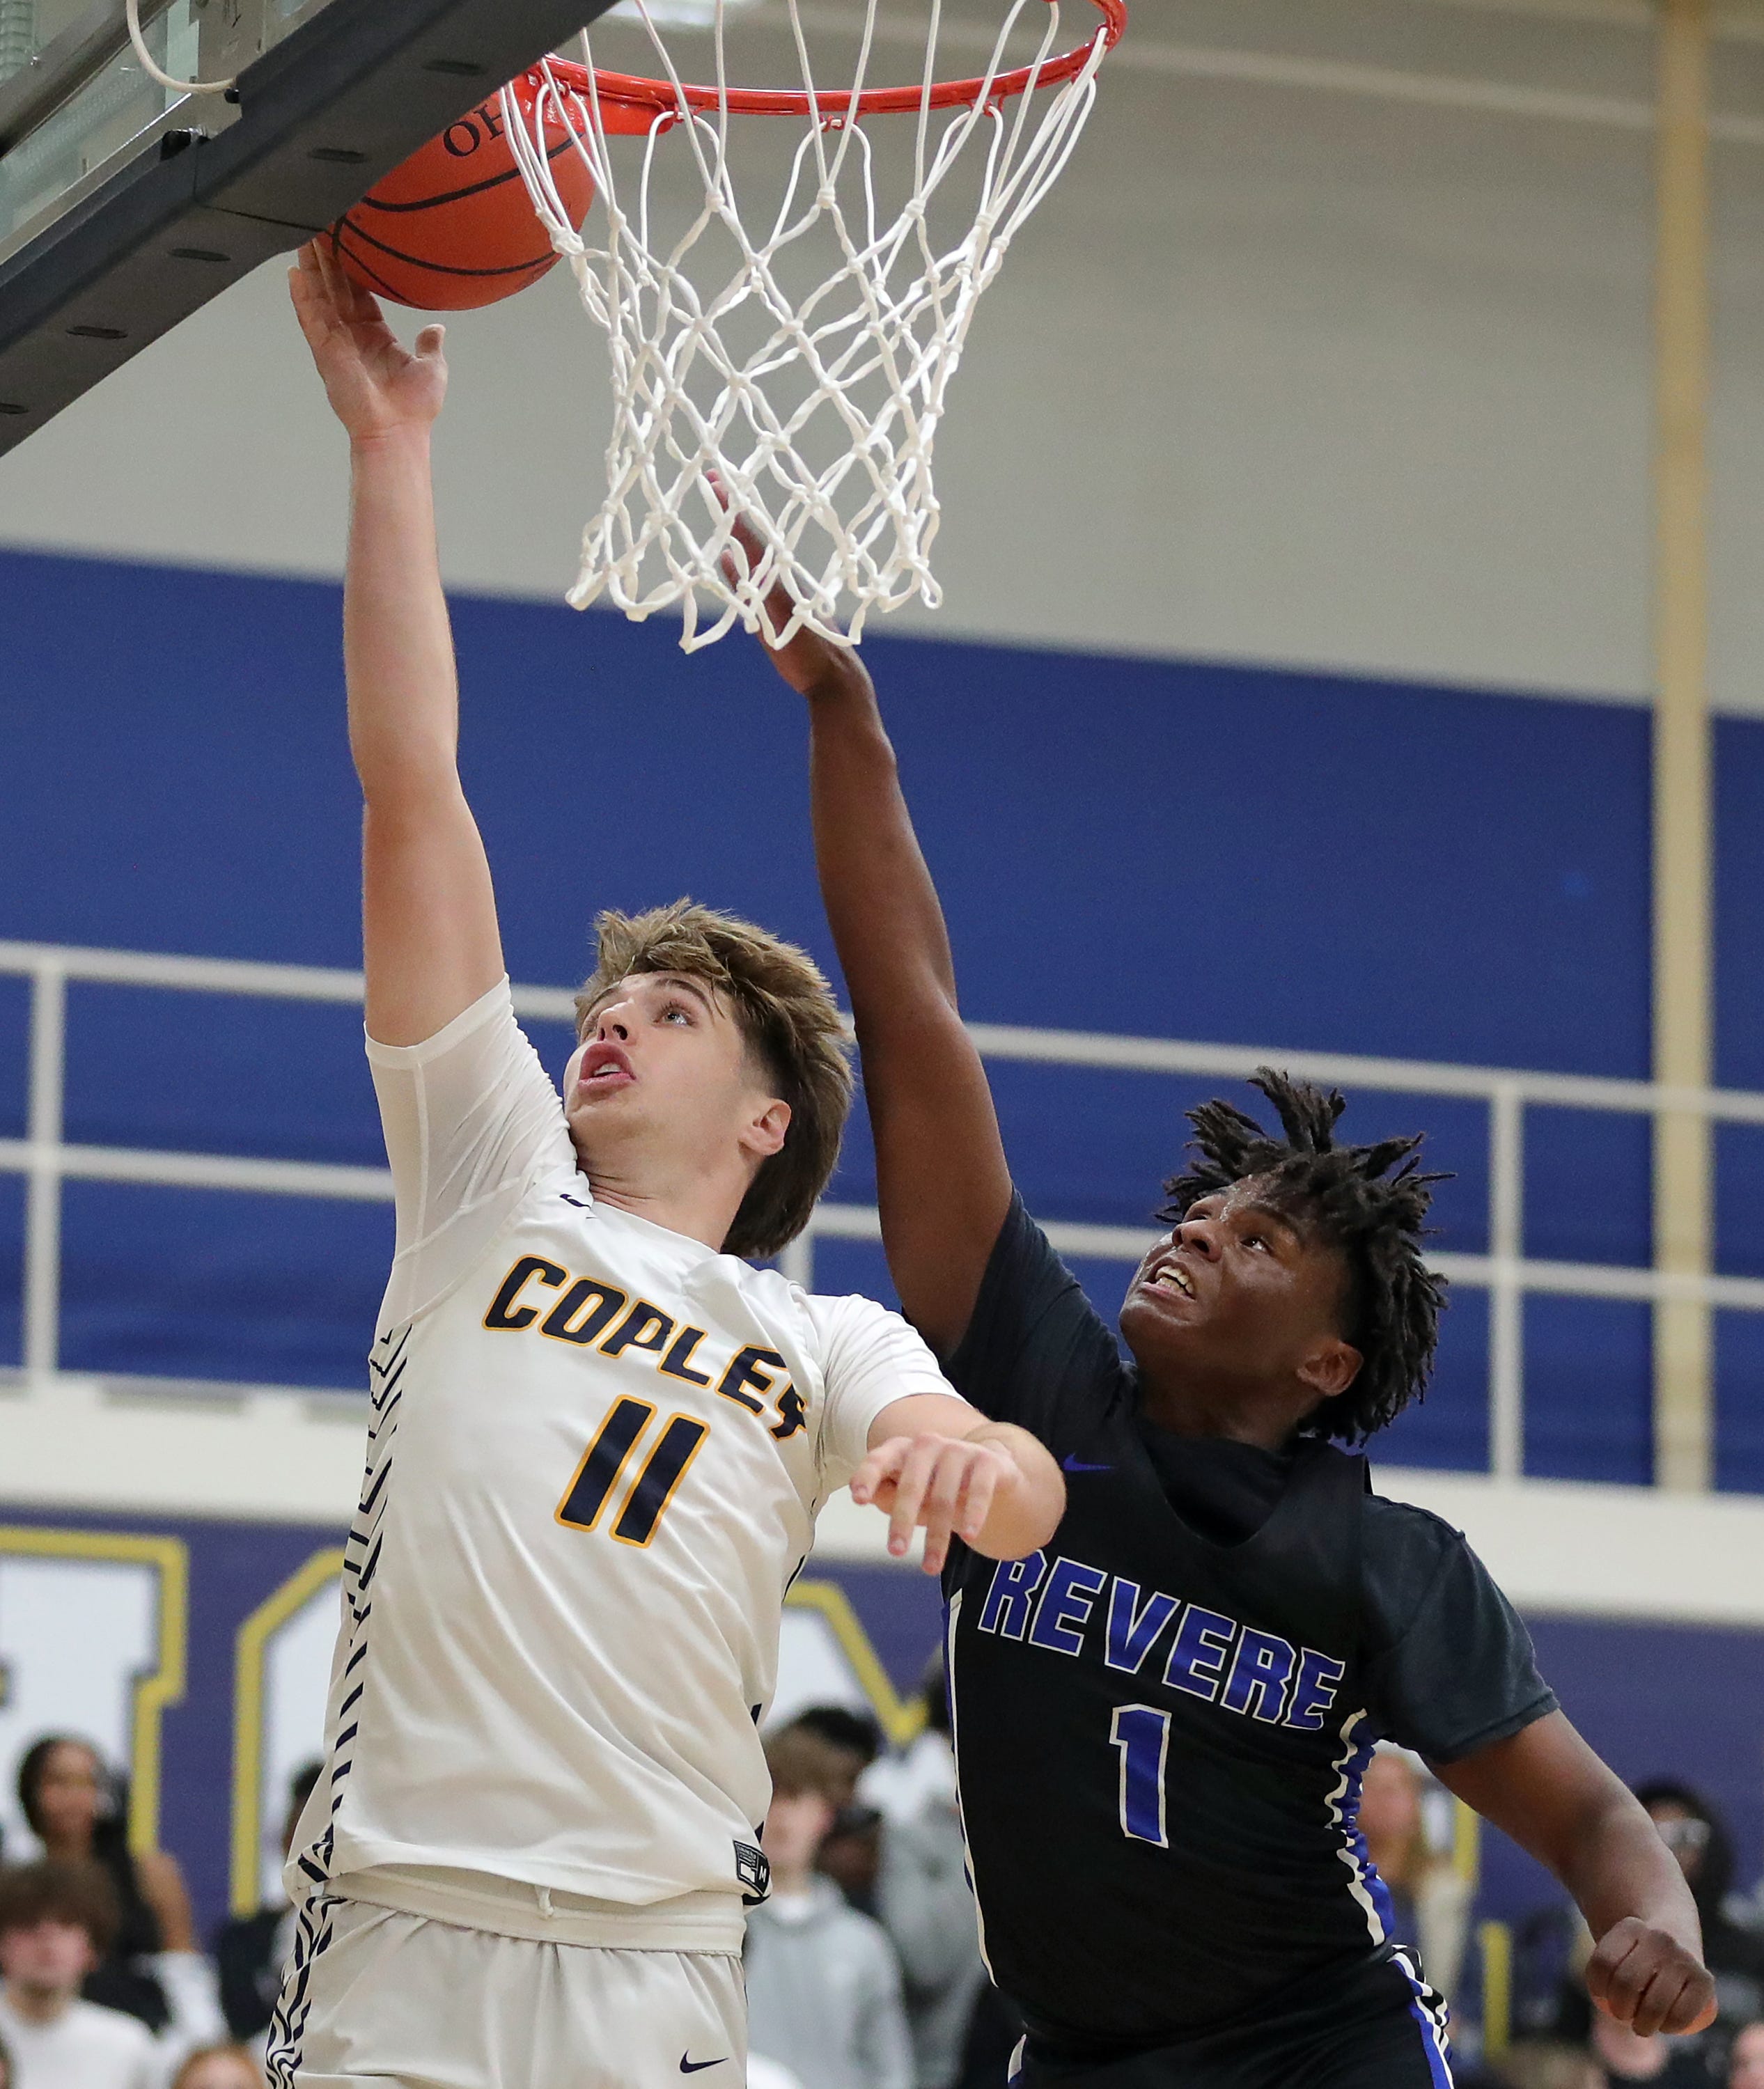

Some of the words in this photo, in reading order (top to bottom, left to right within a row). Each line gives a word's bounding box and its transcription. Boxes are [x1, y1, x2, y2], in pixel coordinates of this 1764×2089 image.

[554, 1394, 710, 1549] 11
[978, 1549, 1345, 1730] REVERE
[1109, 1703, 1171, 1849] 1
